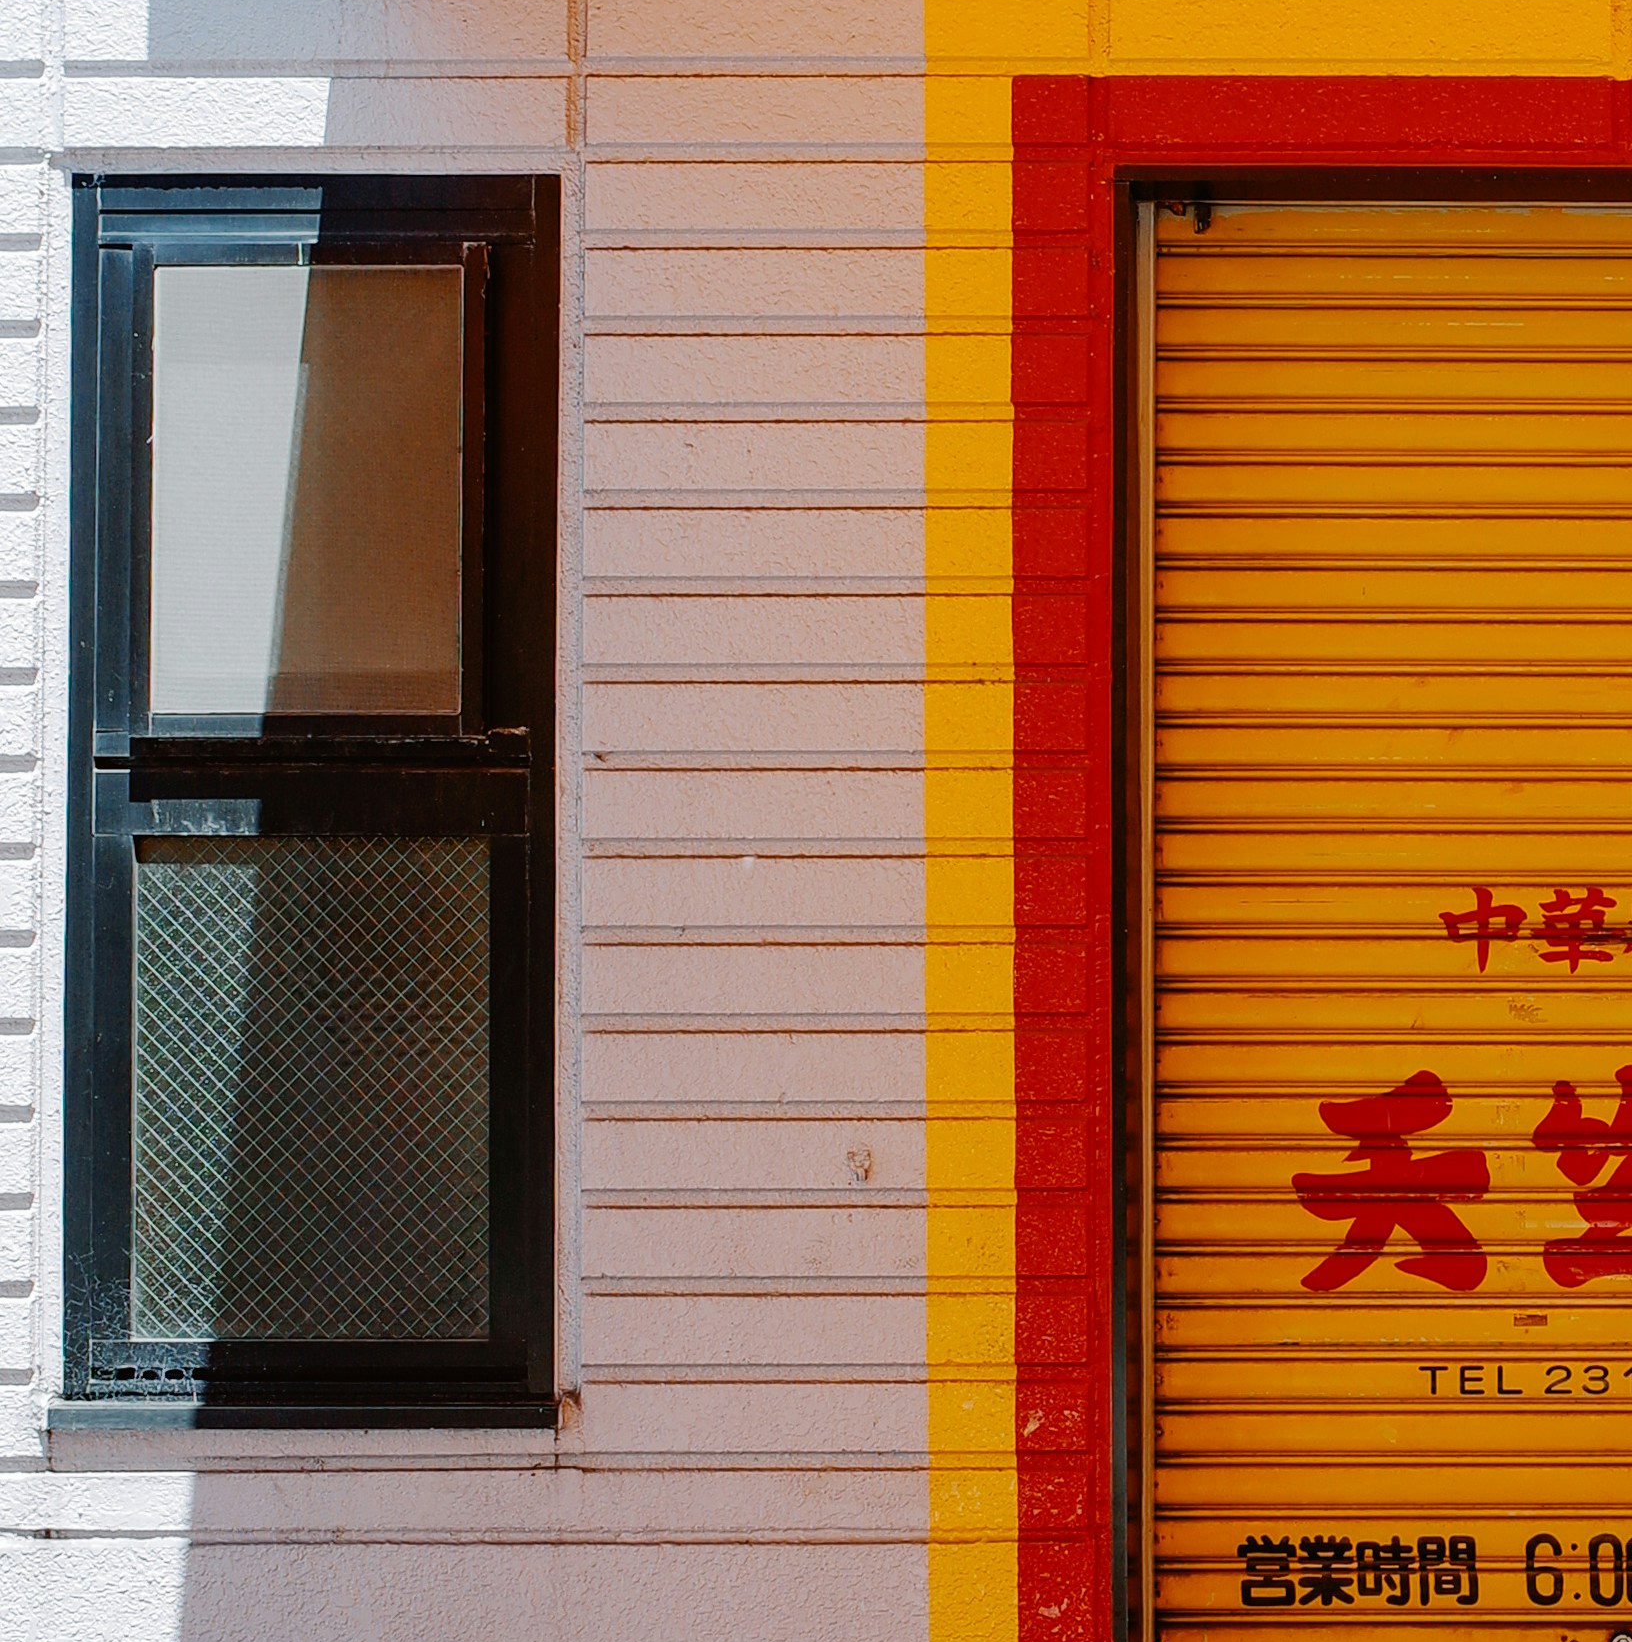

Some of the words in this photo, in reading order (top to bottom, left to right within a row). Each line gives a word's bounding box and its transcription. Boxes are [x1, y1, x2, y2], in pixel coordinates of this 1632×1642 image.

[1418, 1364, 1523, 1395] TEL
[1237, 1534, 1479, 1607] 営業時間
